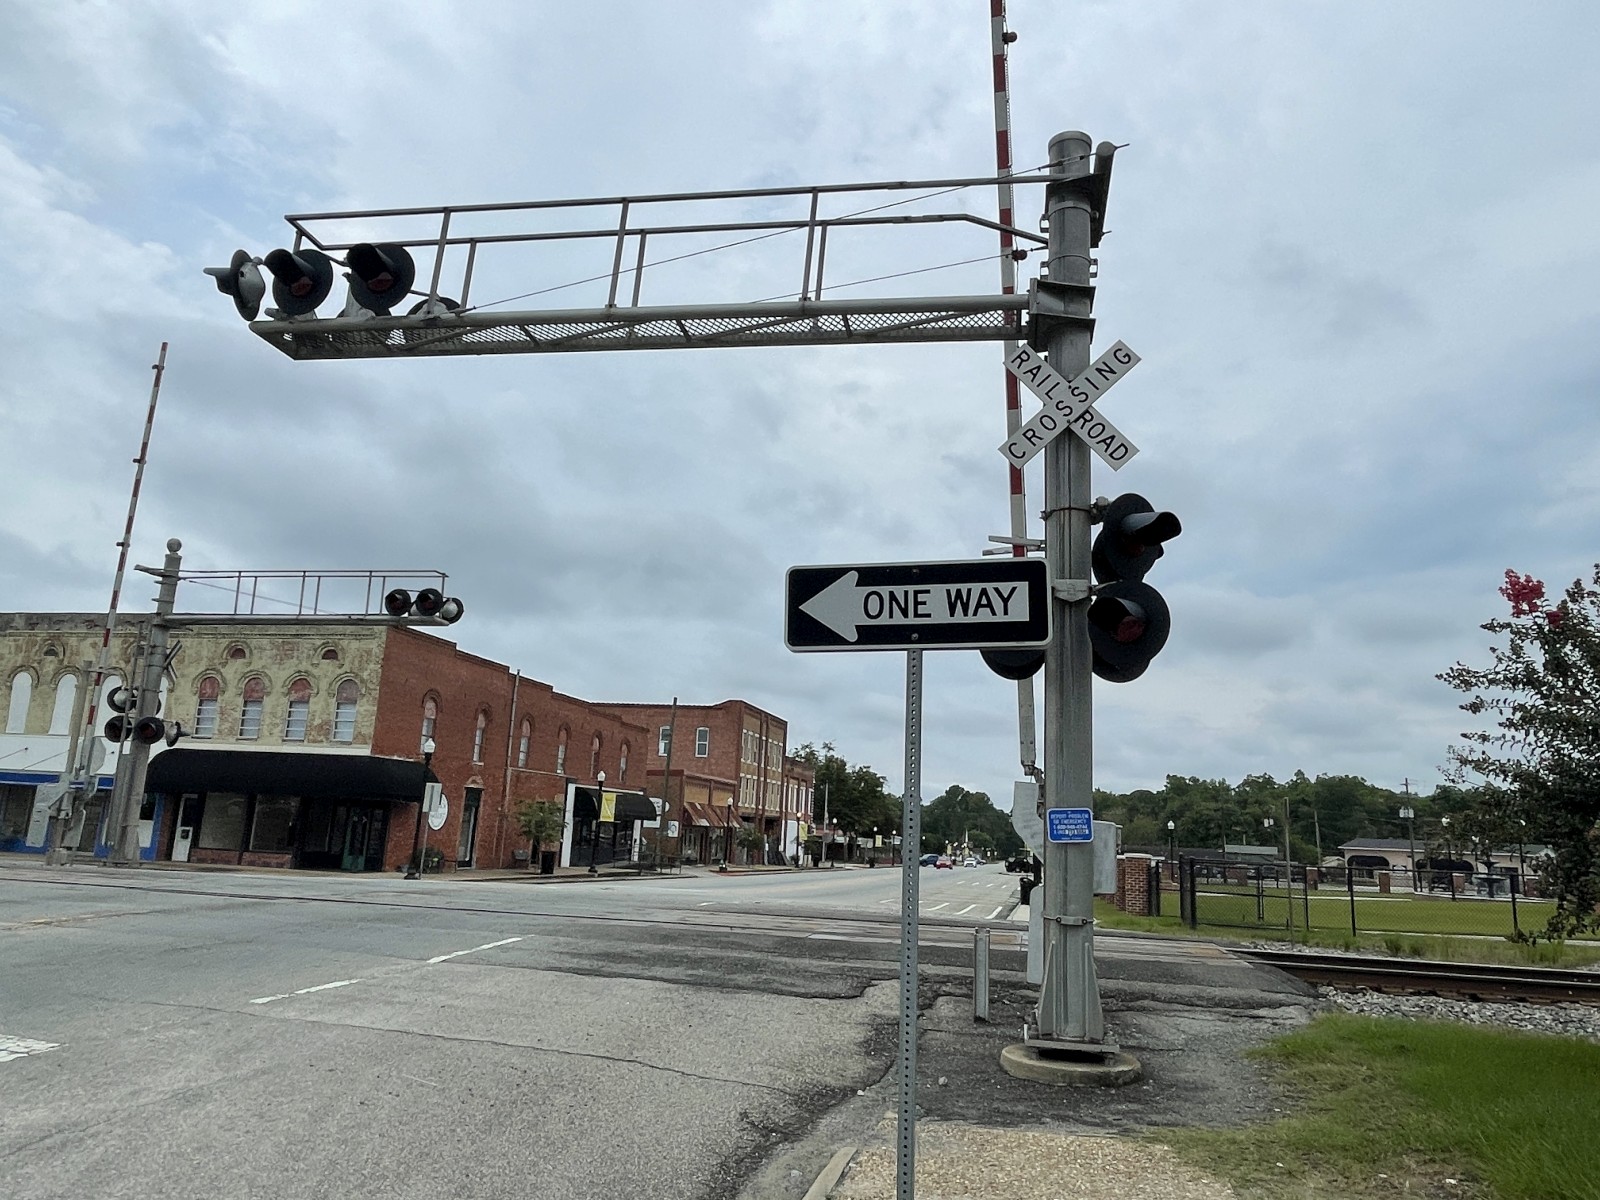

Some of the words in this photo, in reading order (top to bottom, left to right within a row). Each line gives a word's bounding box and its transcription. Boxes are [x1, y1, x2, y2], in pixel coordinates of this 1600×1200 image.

[1008, 348, 1132, 459] CROSSING
[863, 589, 932, 620] ONE
[946, 586, 1018, 618] WAY
